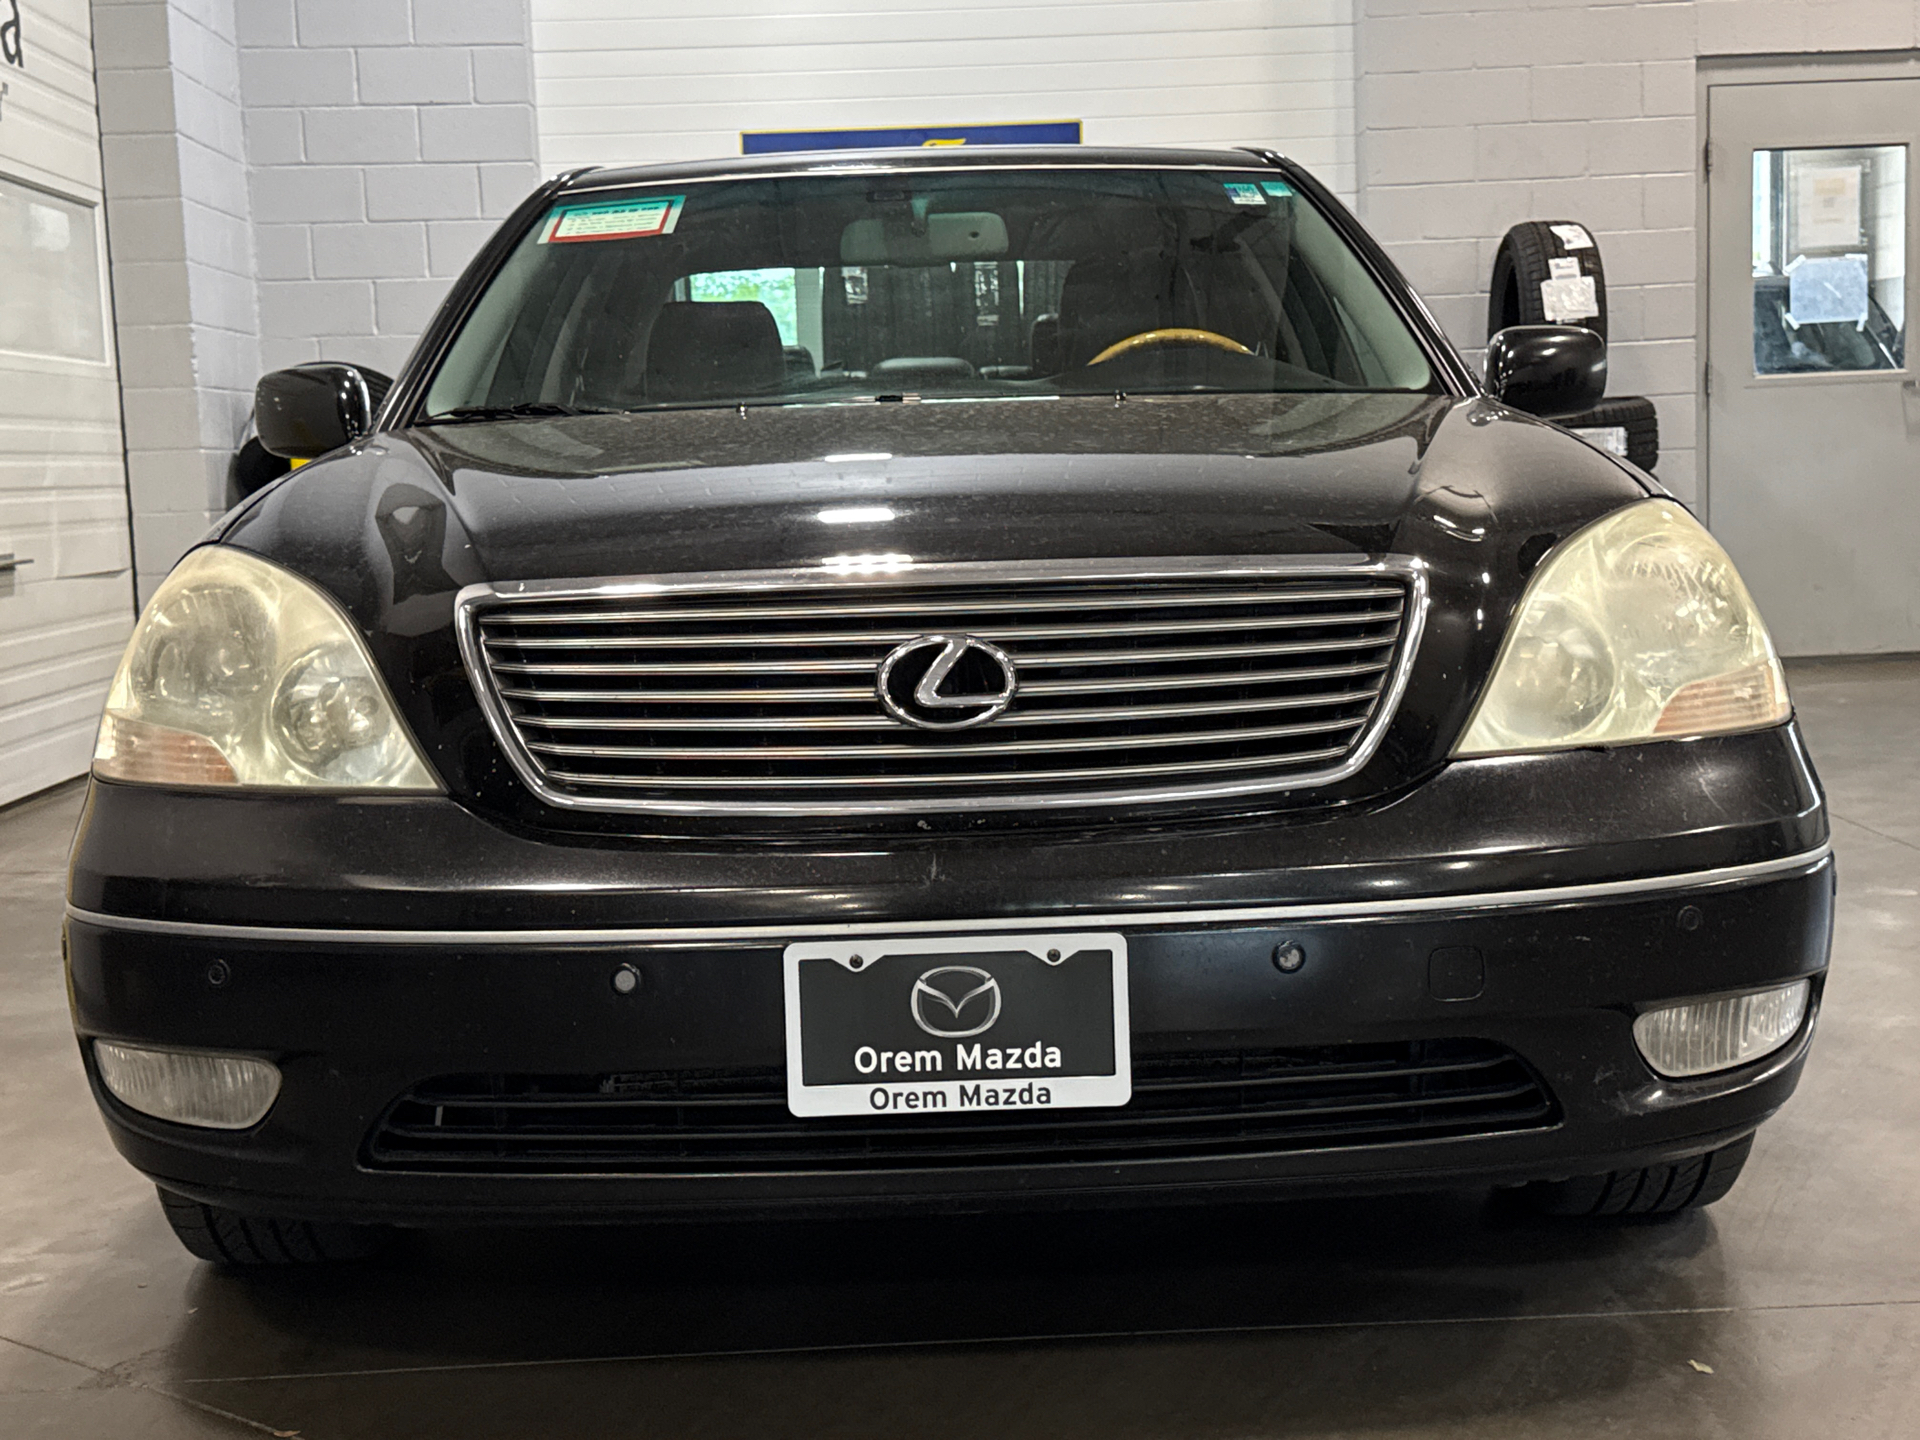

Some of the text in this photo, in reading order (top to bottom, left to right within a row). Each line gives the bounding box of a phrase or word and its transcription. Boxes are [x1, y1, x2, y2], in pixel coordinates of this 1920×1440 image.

[854, 1040, 1062, 1075] Orem Mazda
[869, 1081, 1052, 1111] Orem Mazda
